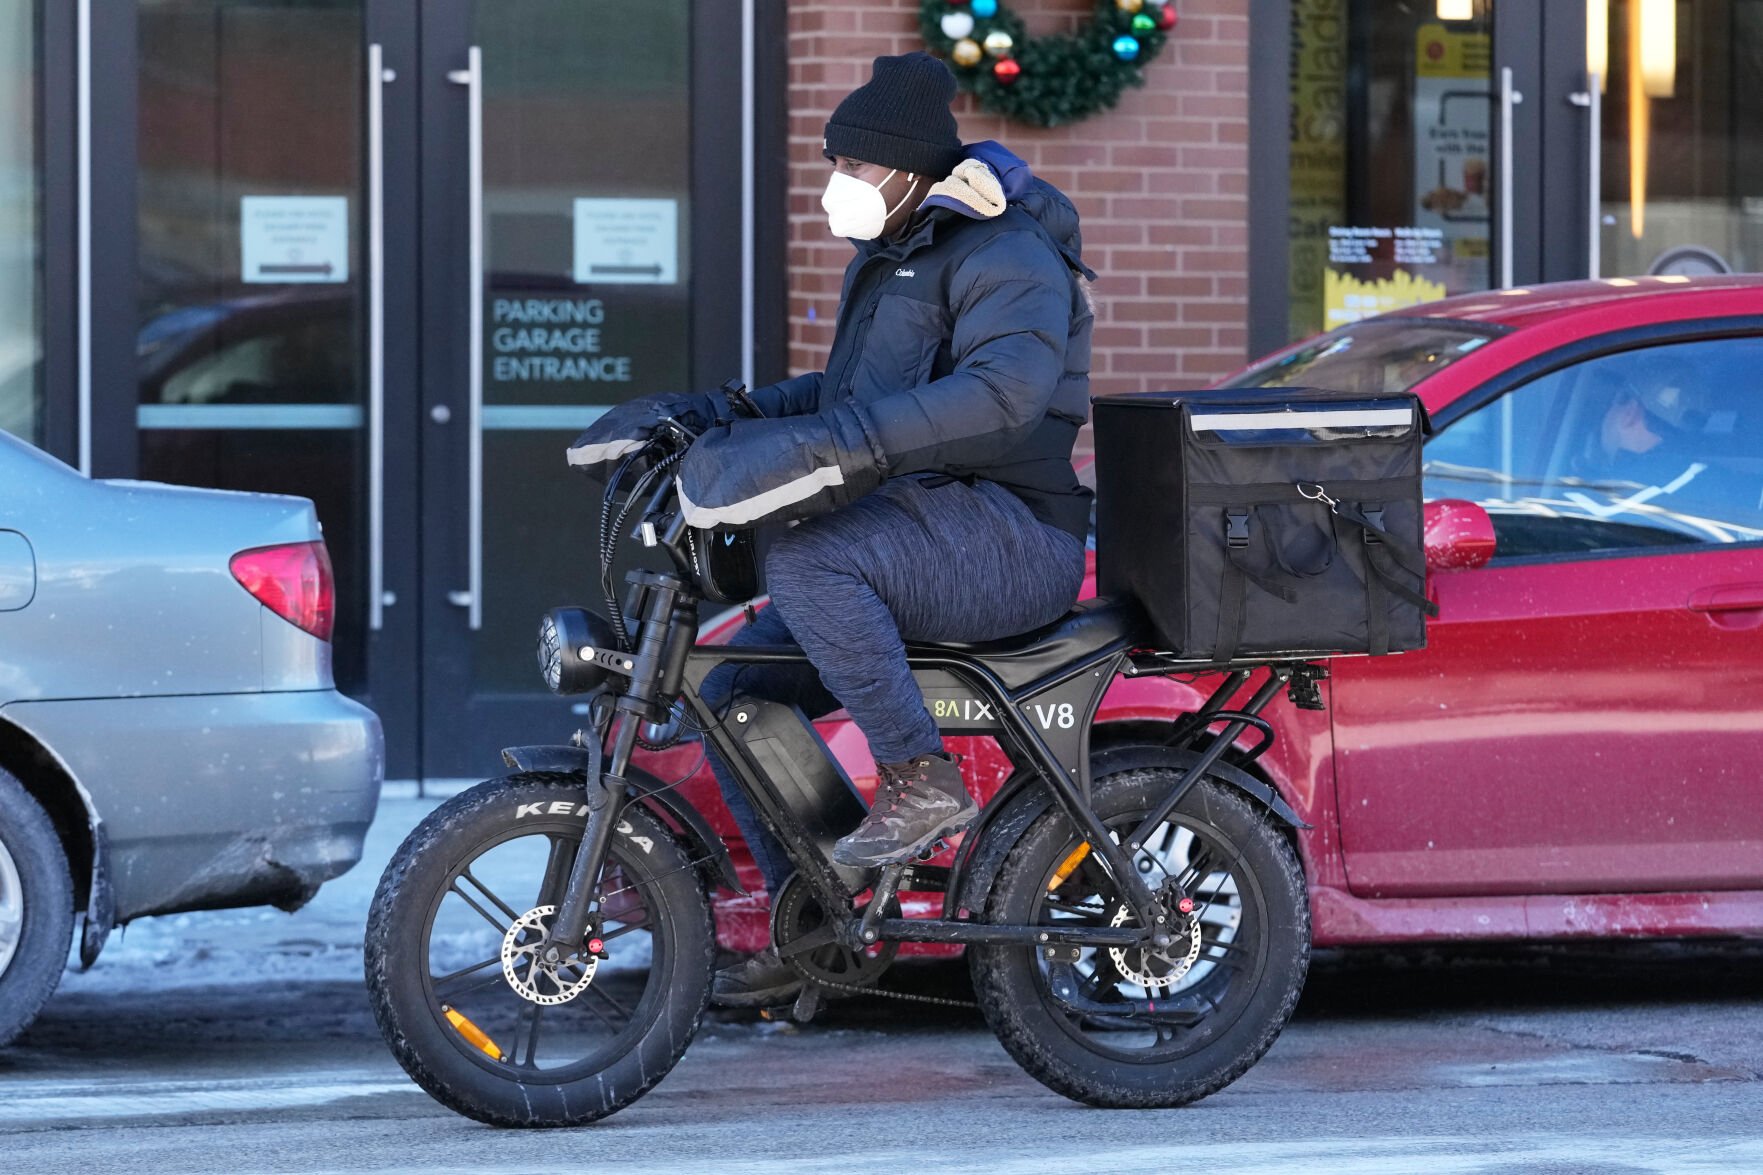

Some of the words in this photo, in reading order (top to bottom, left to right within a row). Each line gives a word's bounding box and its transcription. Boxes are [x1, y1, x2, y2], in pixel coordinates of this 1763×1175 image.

[493, 299, 604, 324] PARKING
[493, 328, 601, 353] GARAGE
[493, 356, 632, 381] ENTRANCE
[1035, 703, 1075, 729] V8
